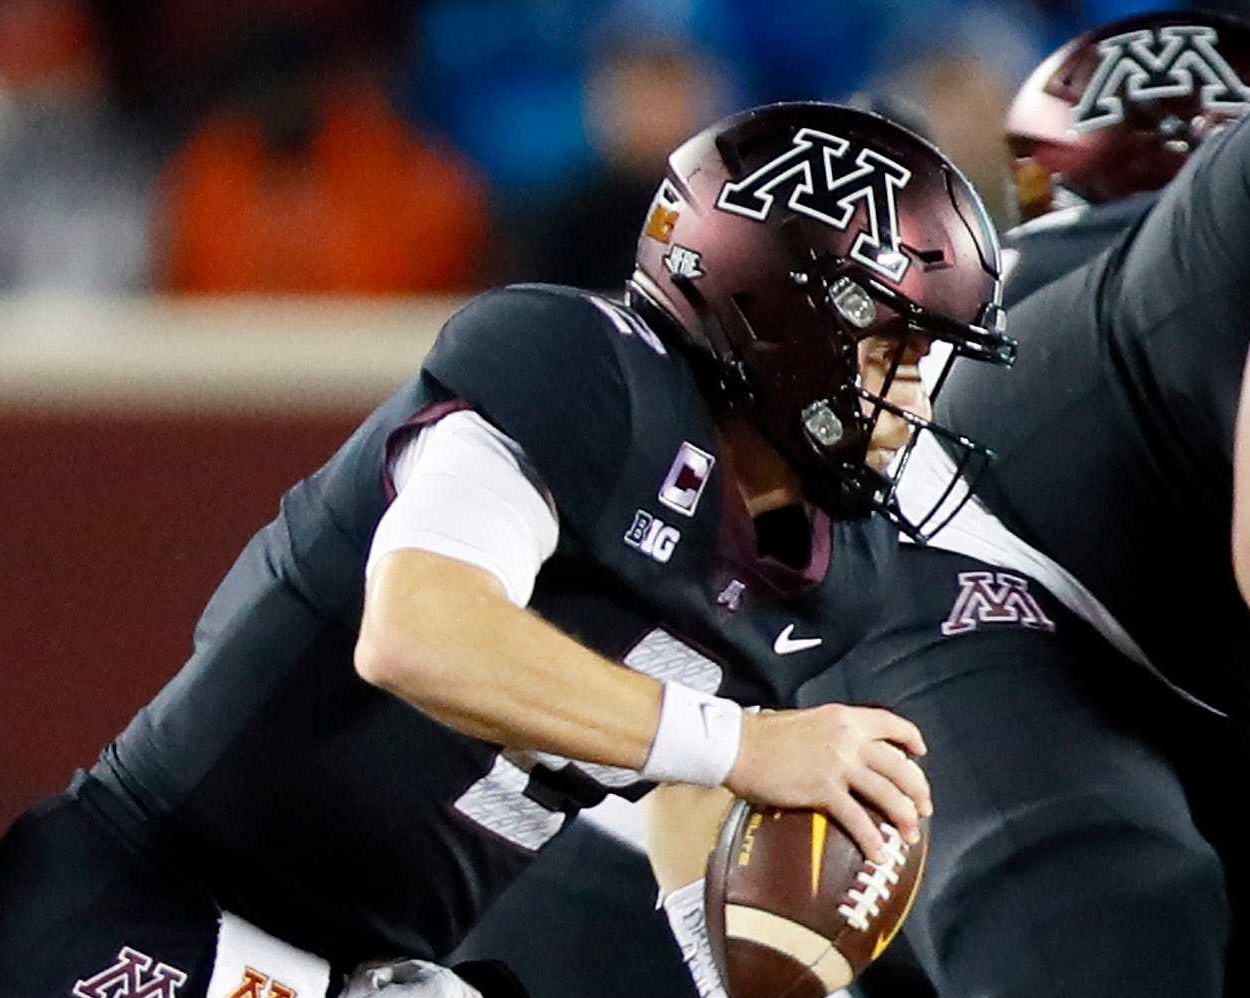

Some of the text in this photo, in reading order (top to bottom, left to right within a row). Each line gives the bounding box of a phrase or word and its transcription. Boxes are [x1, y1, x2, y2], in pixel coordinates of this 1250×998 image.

[1069, 25, 1250, 135] M
[715, 127, 912, 282] M
[942, 571, 1054, 635] M
